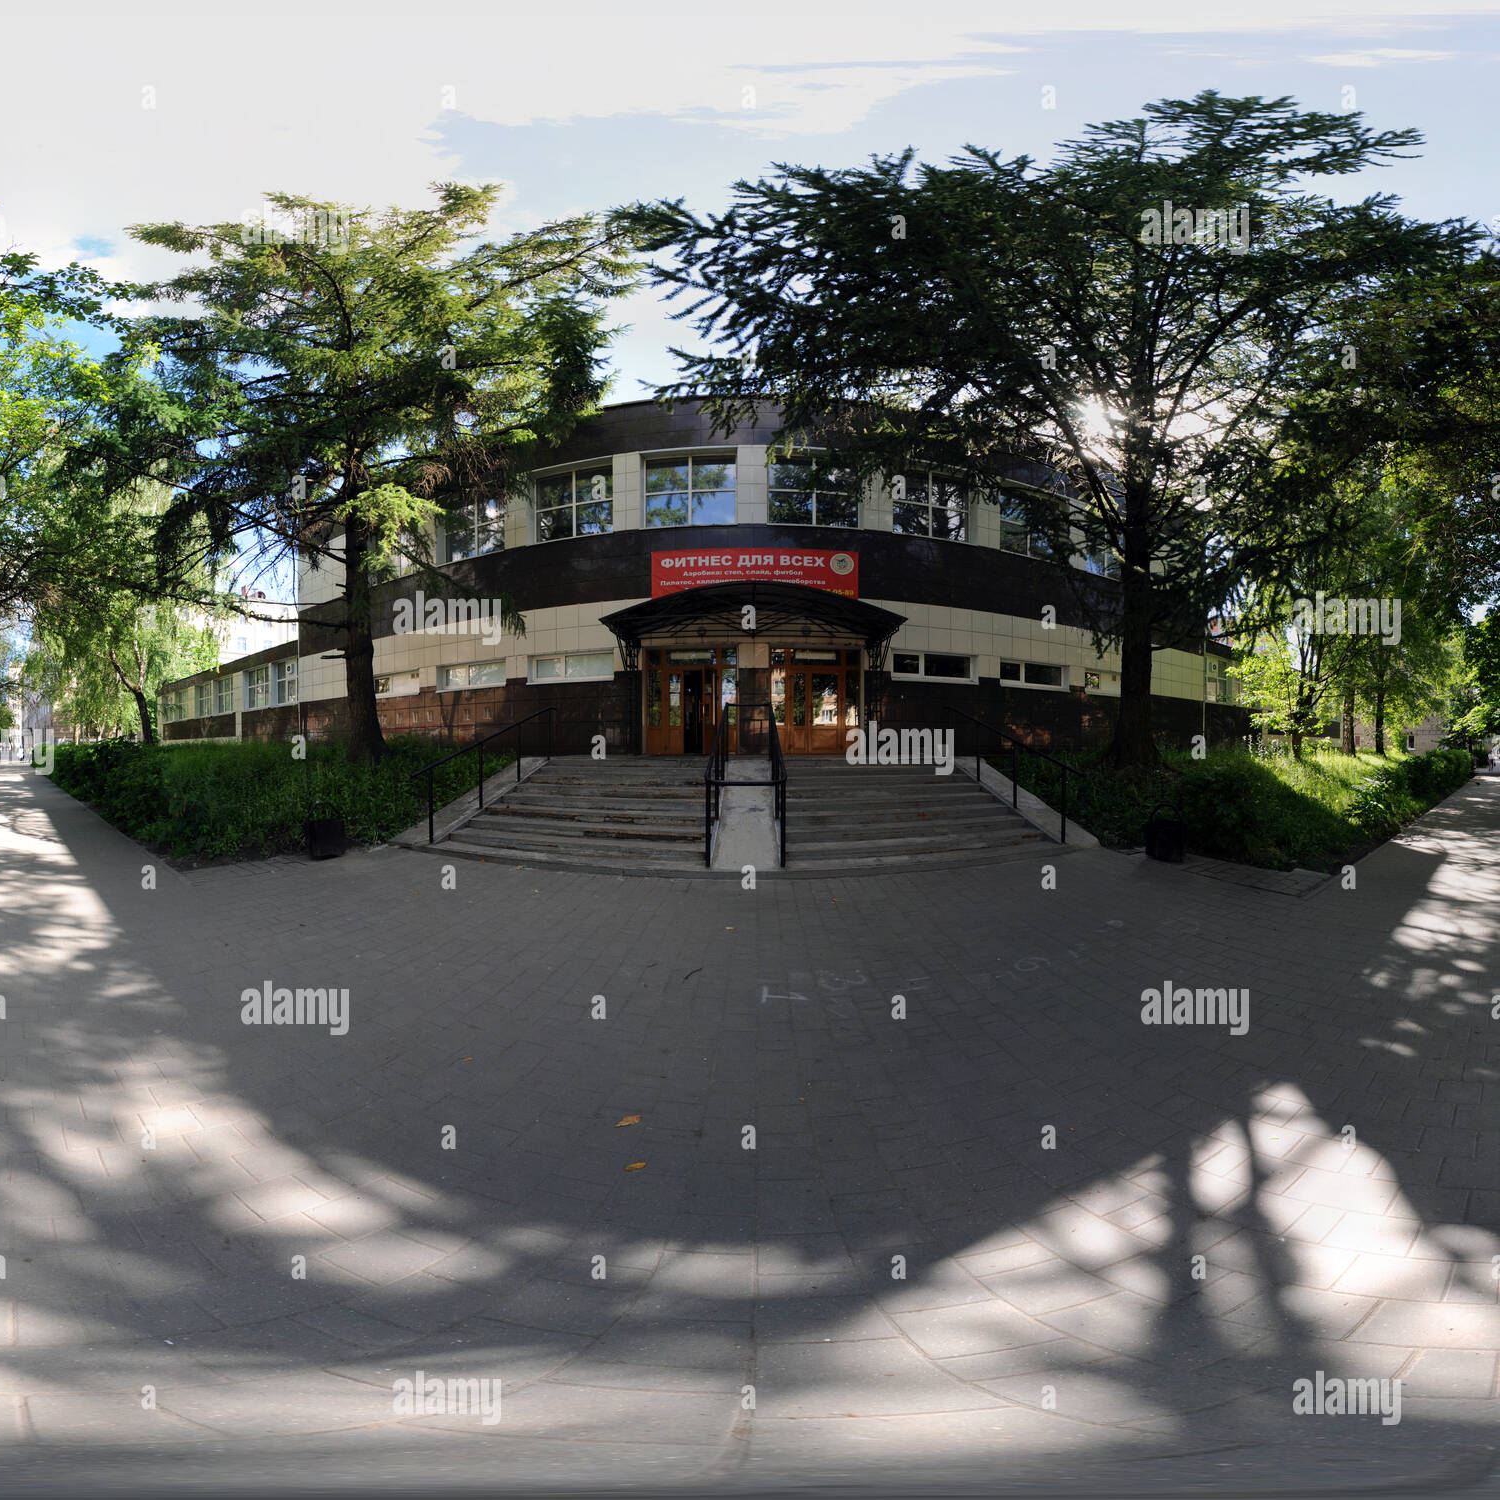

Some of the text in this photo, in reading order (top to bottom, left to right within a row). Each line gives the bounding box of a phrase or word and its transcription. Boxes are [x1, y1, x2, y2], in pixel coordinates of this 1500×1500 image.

[660, 554, 825, 568] ФИТНЕС ДЛЯ ВСЕХ
